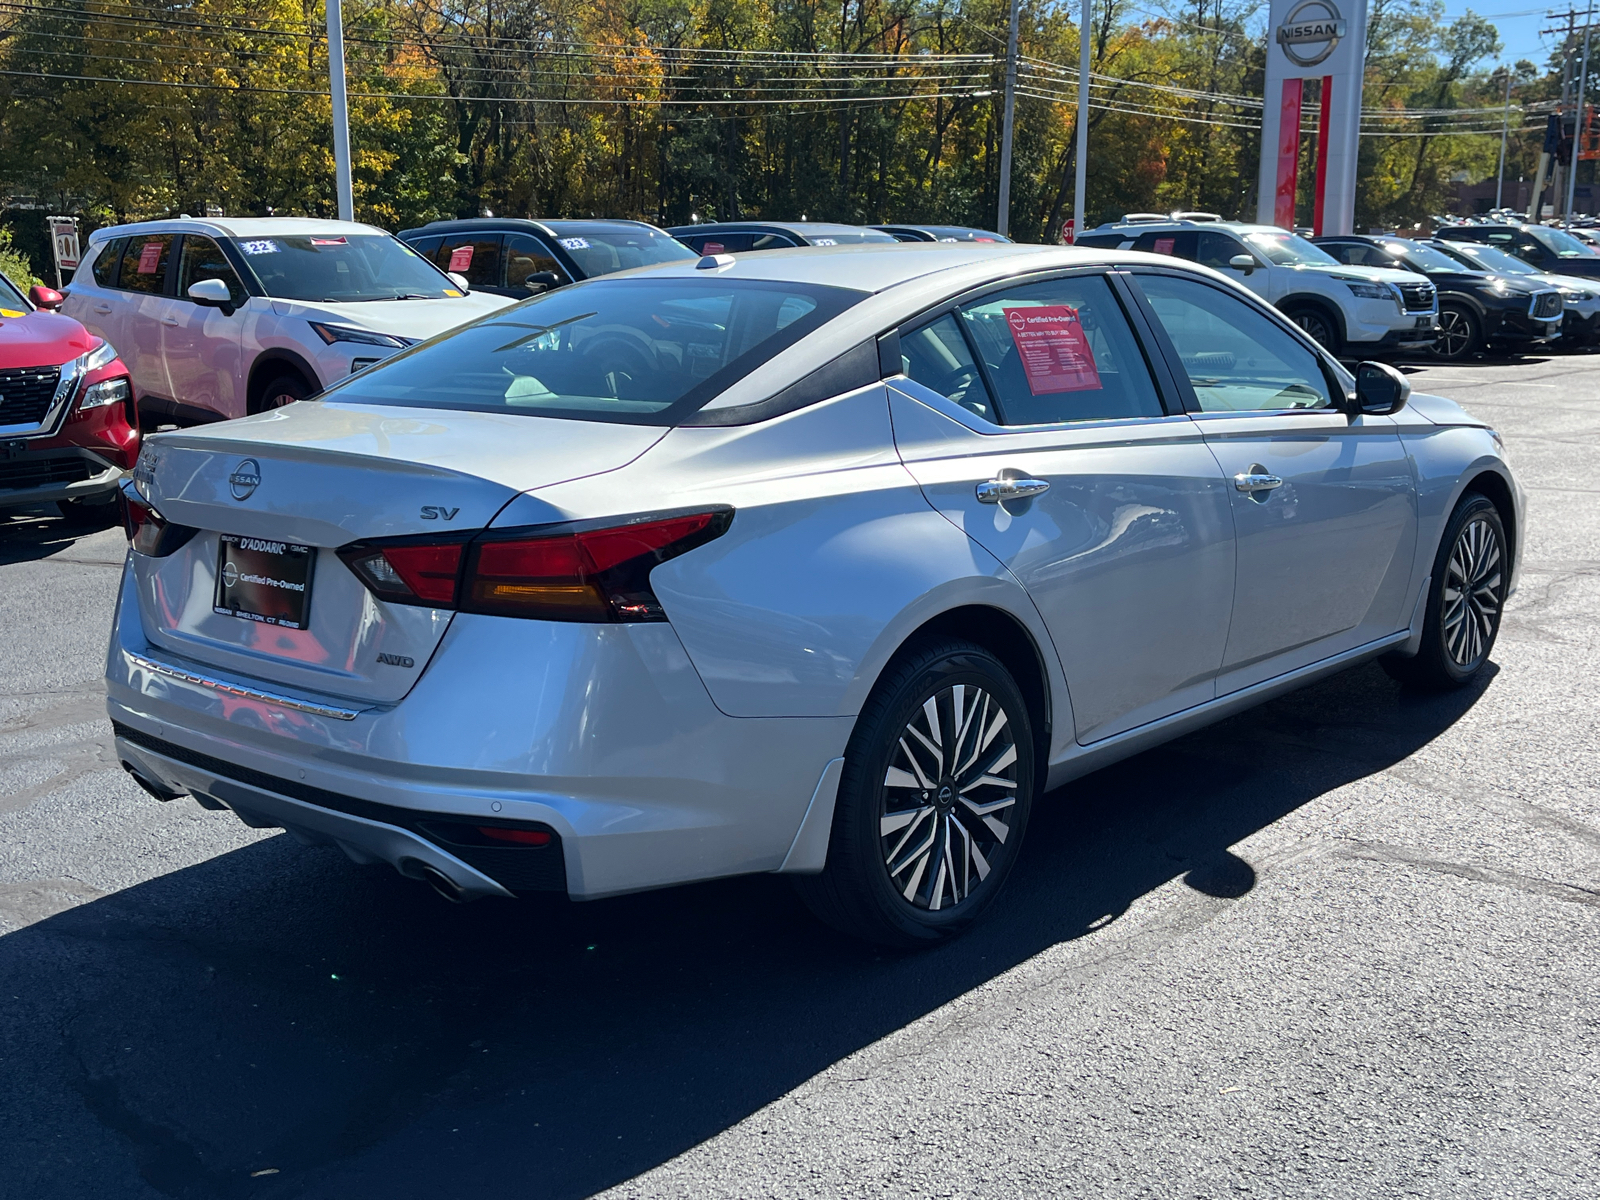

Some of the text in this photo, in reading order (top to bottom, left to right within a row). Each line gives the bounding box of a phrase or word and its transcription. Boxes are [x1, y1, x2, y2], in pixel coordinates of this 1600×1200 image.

[1282, 23, 1338, 39] NISSAN
[250, 243, 269, 251] 22
[567, 239, 583, 248] 23
[231, 474, 260, 486] SSAN
[419, 505, 461, 521] SV
[221, 535, 239, 543] BUICK
[290, 544, 309, 553] GMC
[240, 572, 305, 592] Certified Pre-Owned
[214, 606, 233, 616] NISSAN
[266, 616, 276, 624] CT
[376, 652, 415, 668] AWD
